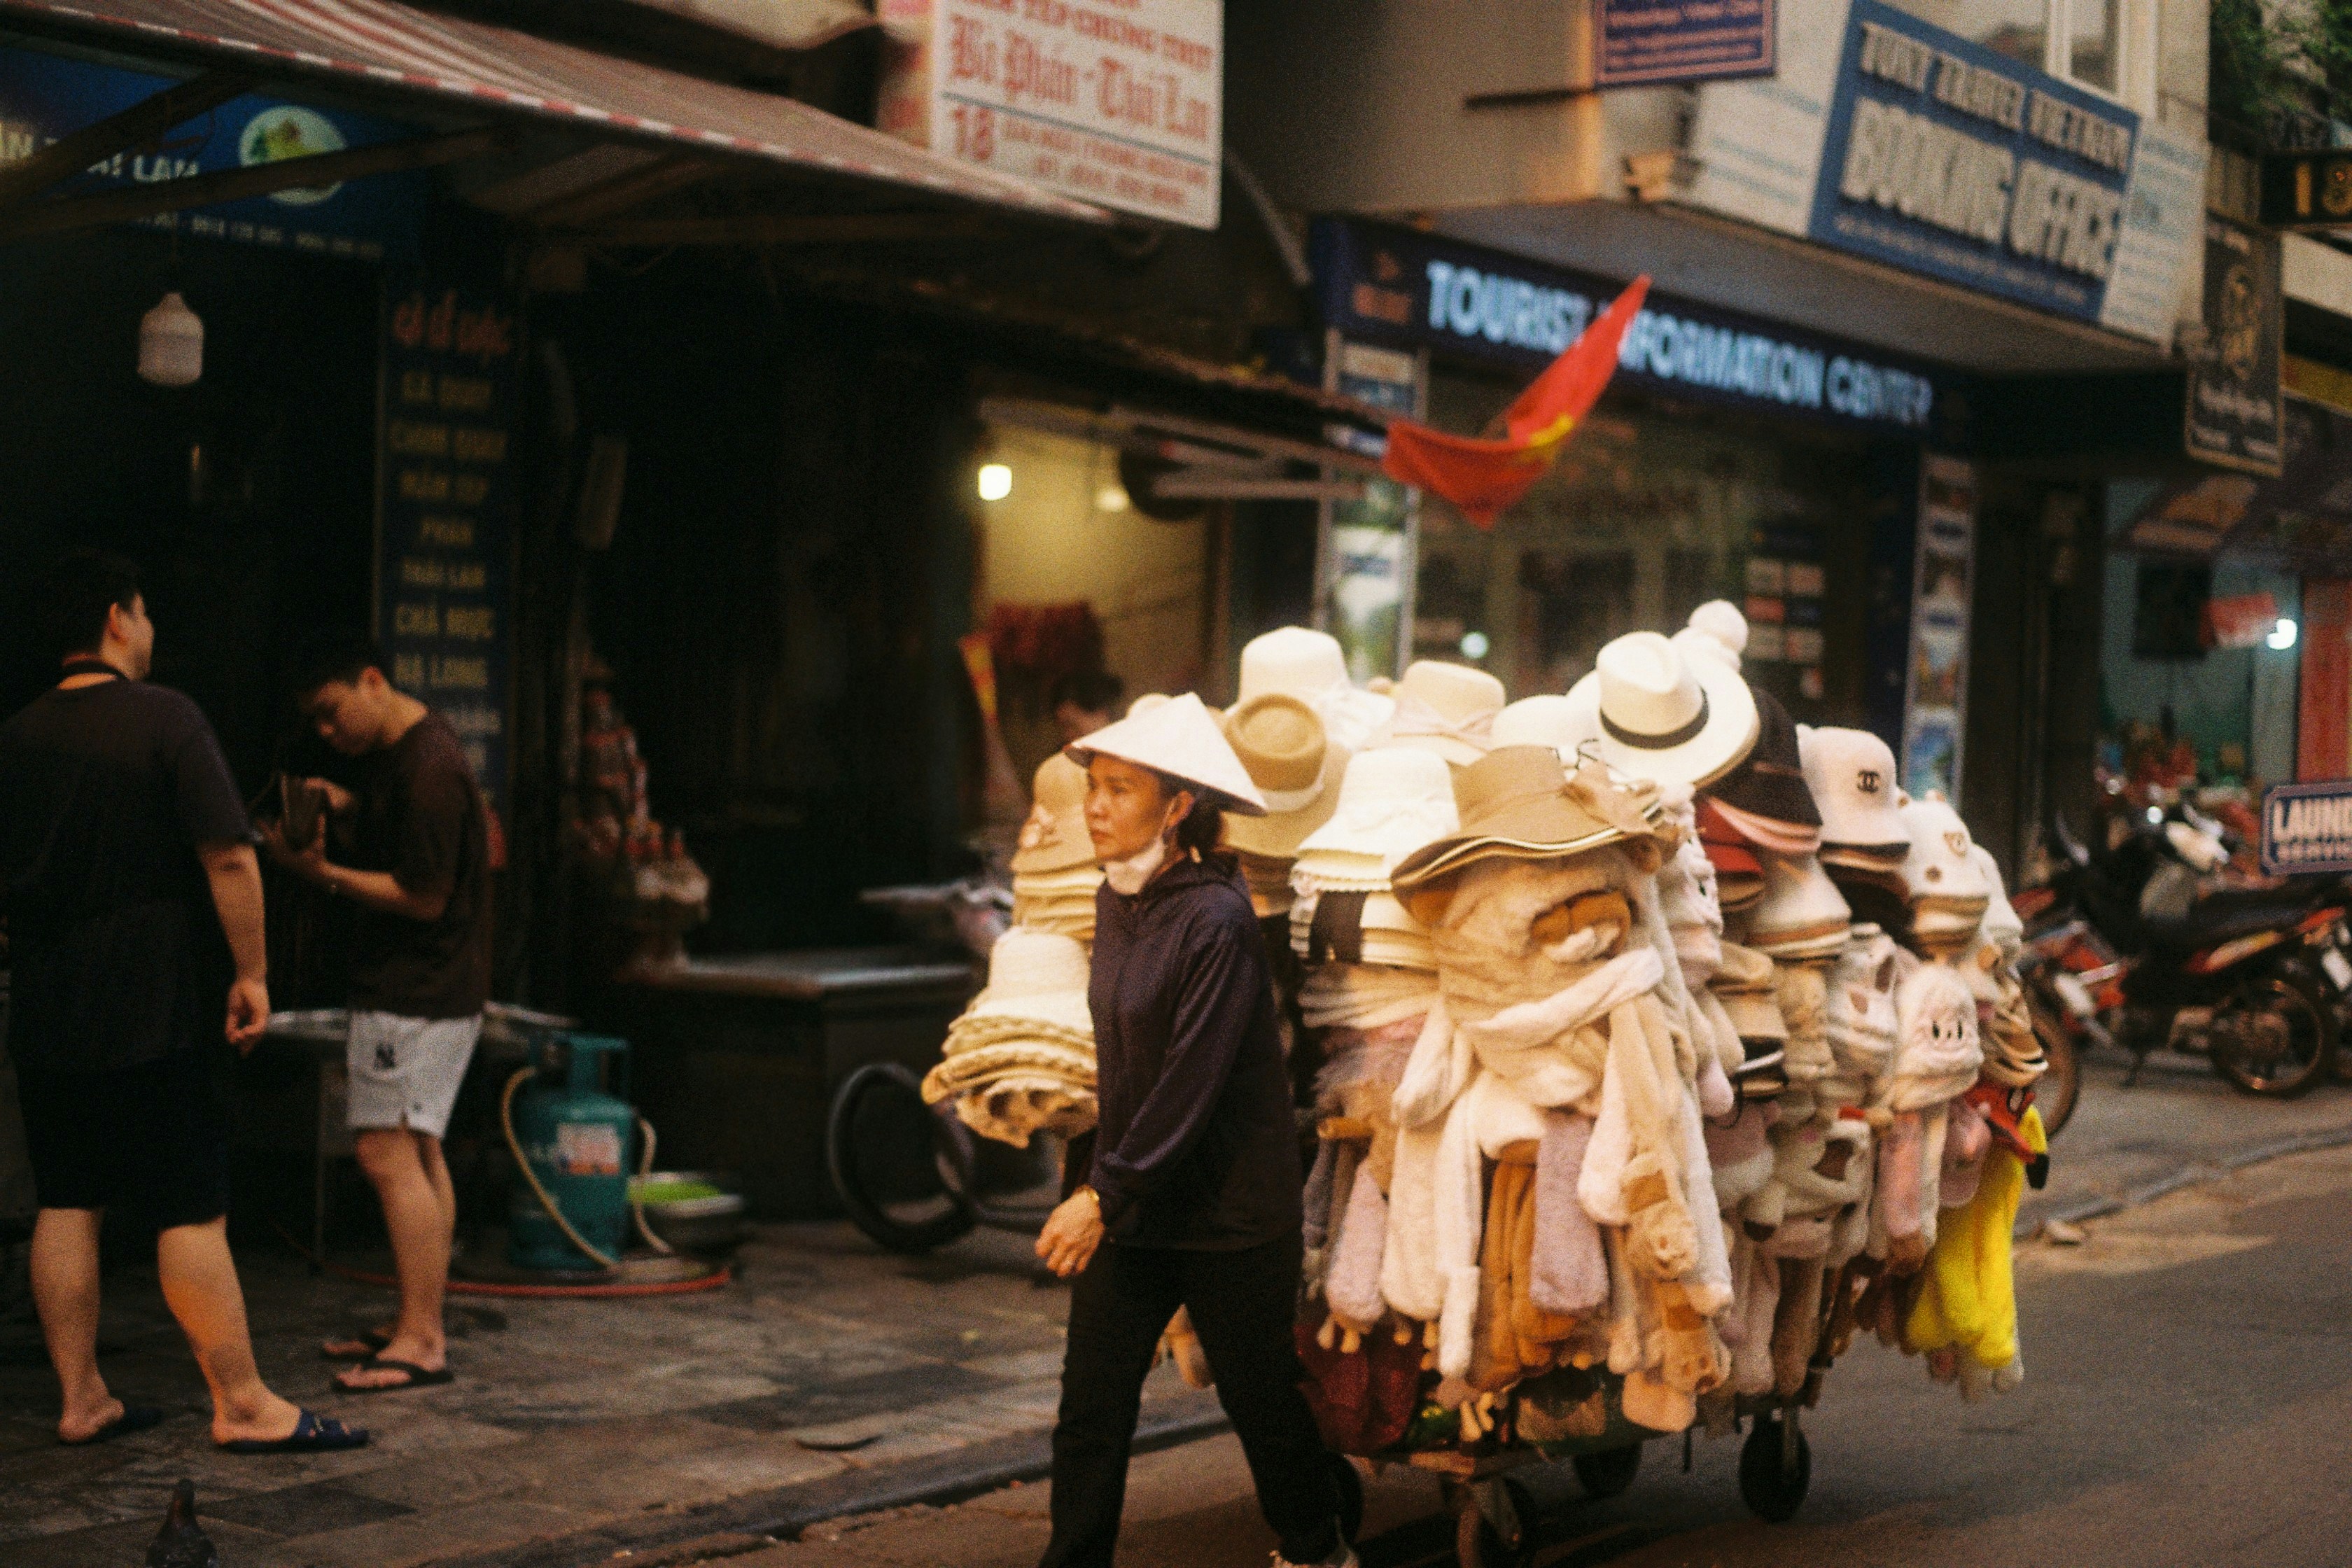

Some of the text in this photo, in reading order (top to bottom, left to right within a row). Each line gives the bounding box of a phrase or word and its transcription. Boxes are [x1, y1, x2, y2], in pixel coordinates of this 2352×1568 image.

[1839, 95, 2017, 245] BOOKING
[2008, 157, 2122, 281] OFFICE
[1426, 259, 1592, 356] TOURIST
[1597, 298, 1828, 410] NFORMATION
[1826, 354, 1934, 430] CENTER
